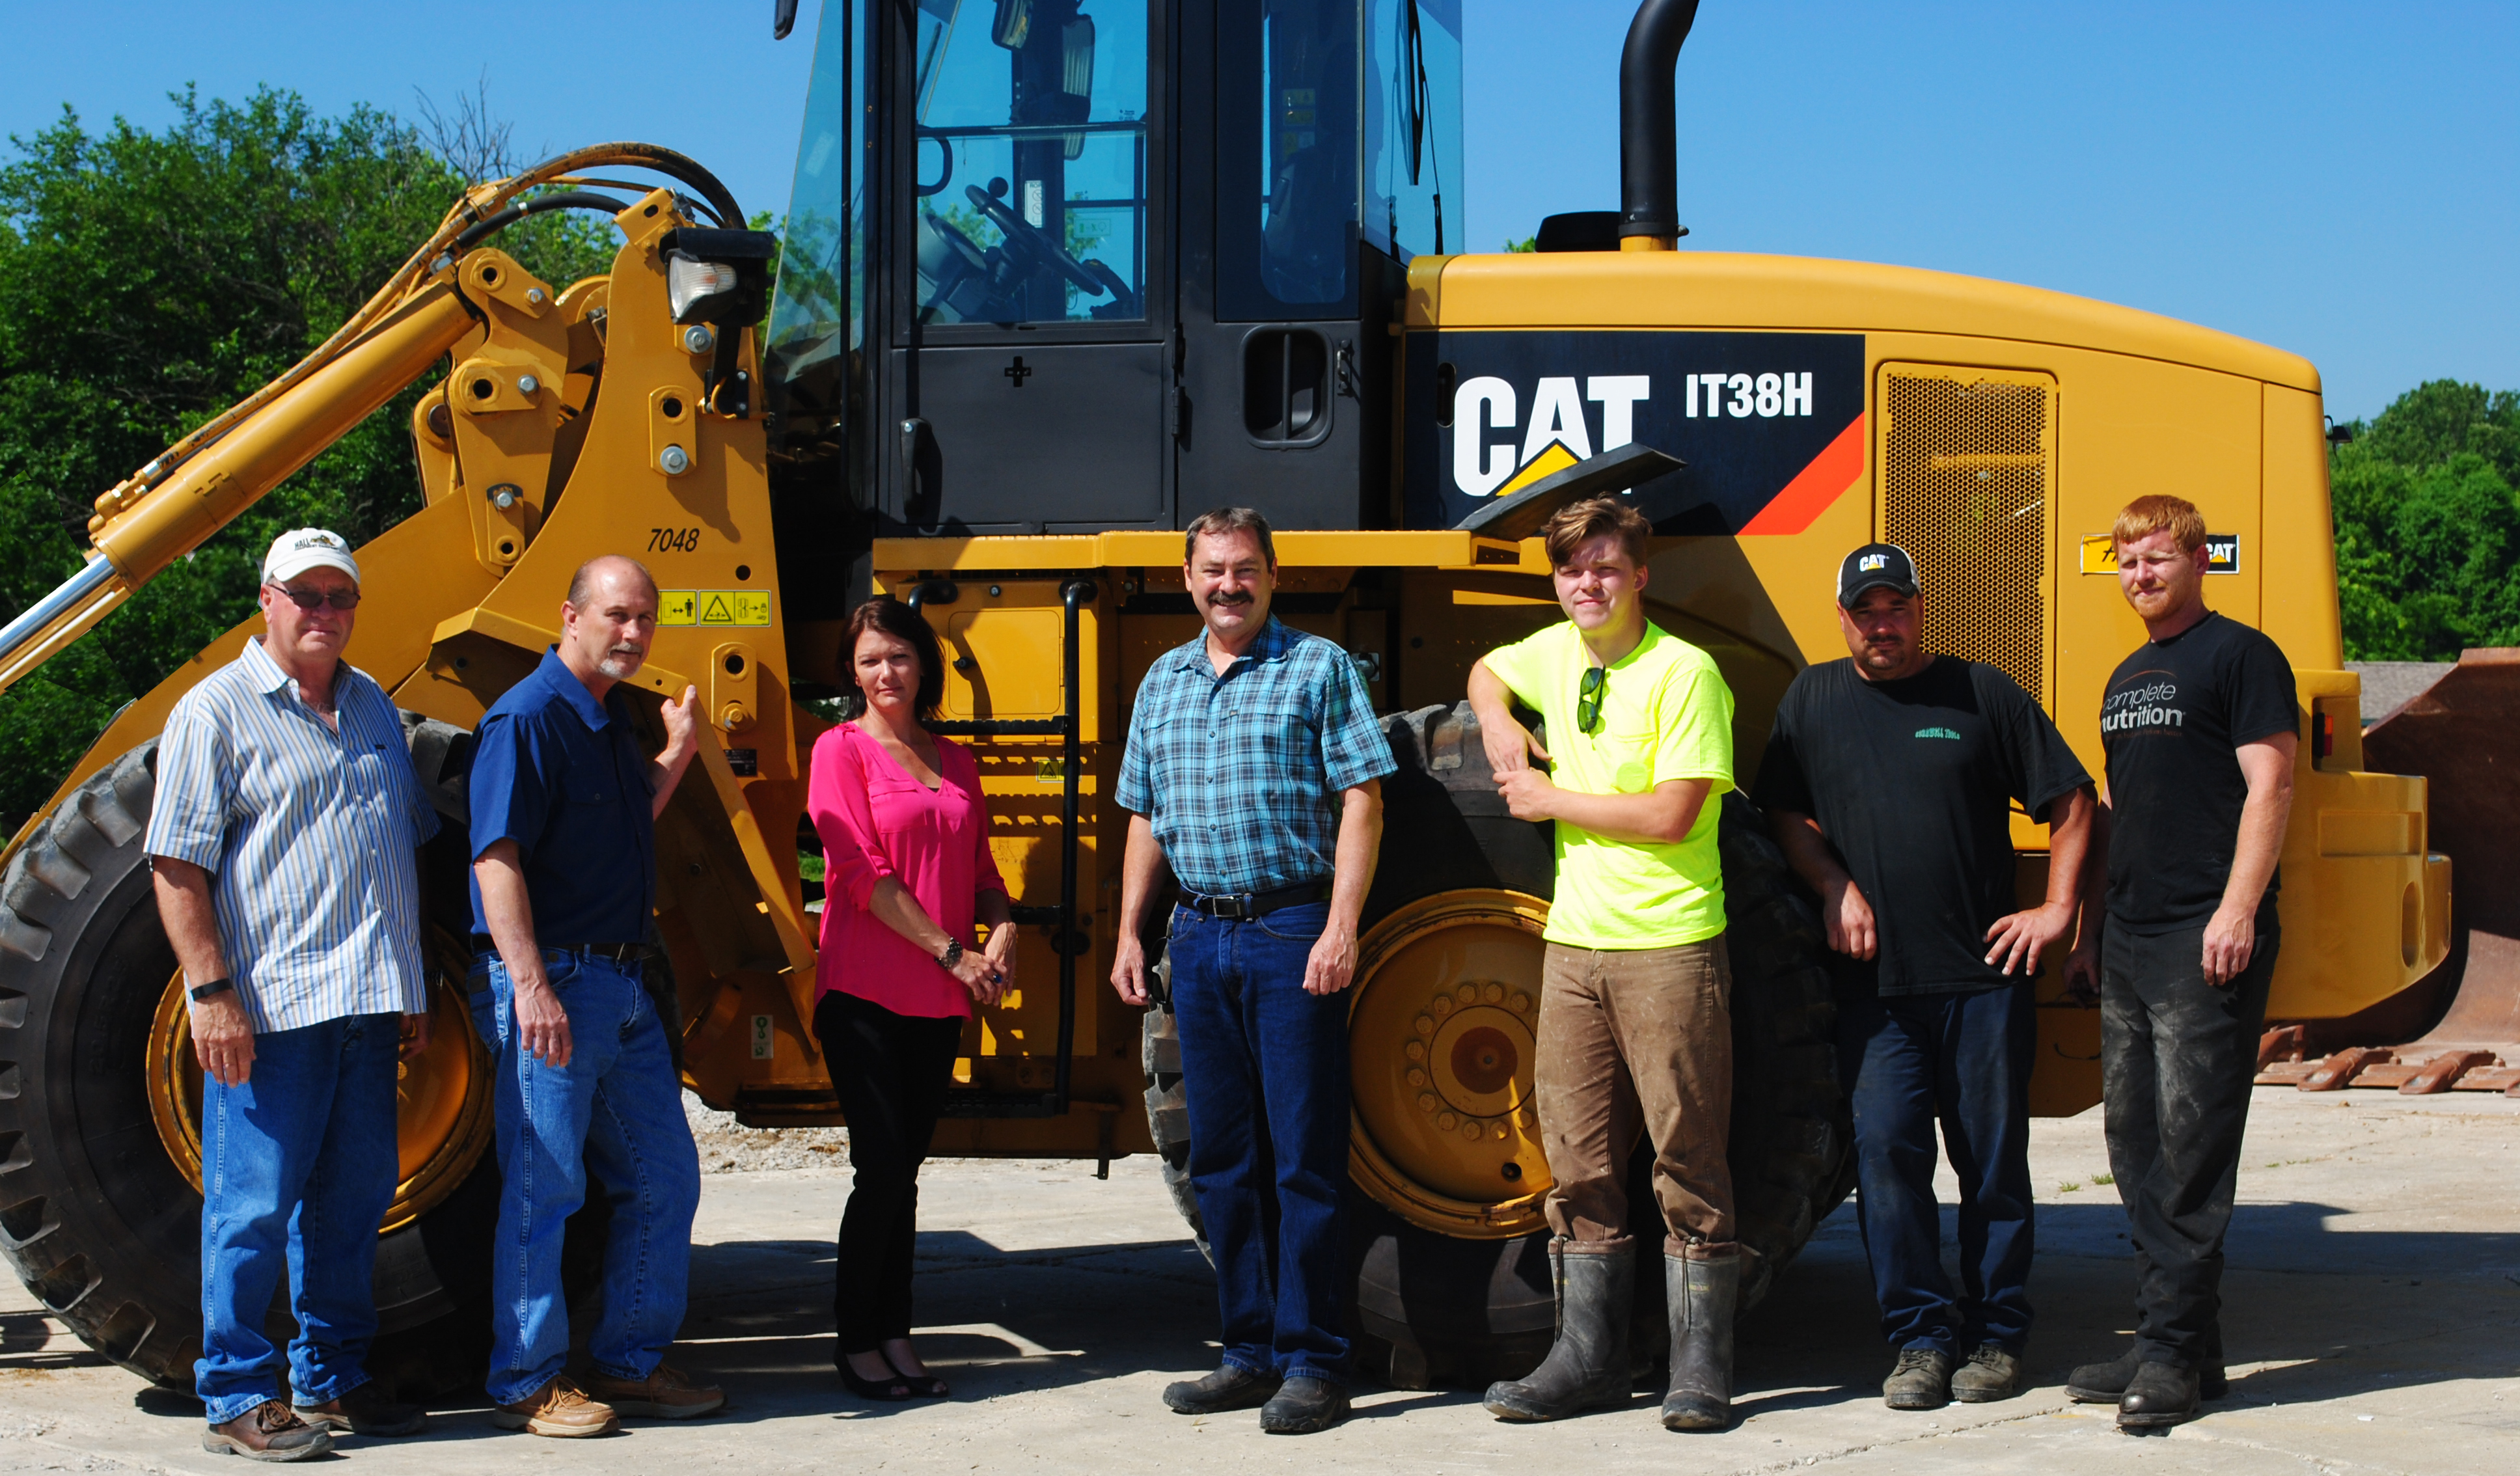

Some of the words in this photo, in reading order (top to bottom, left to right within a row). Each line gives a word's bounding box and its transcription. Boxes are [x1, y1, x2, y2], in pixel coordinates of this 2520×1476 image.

[1686, 372, 1813, 418] IT38H
[1454, 375, 1650, 497] CAT
[295, 538, 310, 548] HALL
[648, 528, 700, 553] 7048
[1859, 554, 1885, 572] CAT
[2103, 681, 2176, 714] complete
